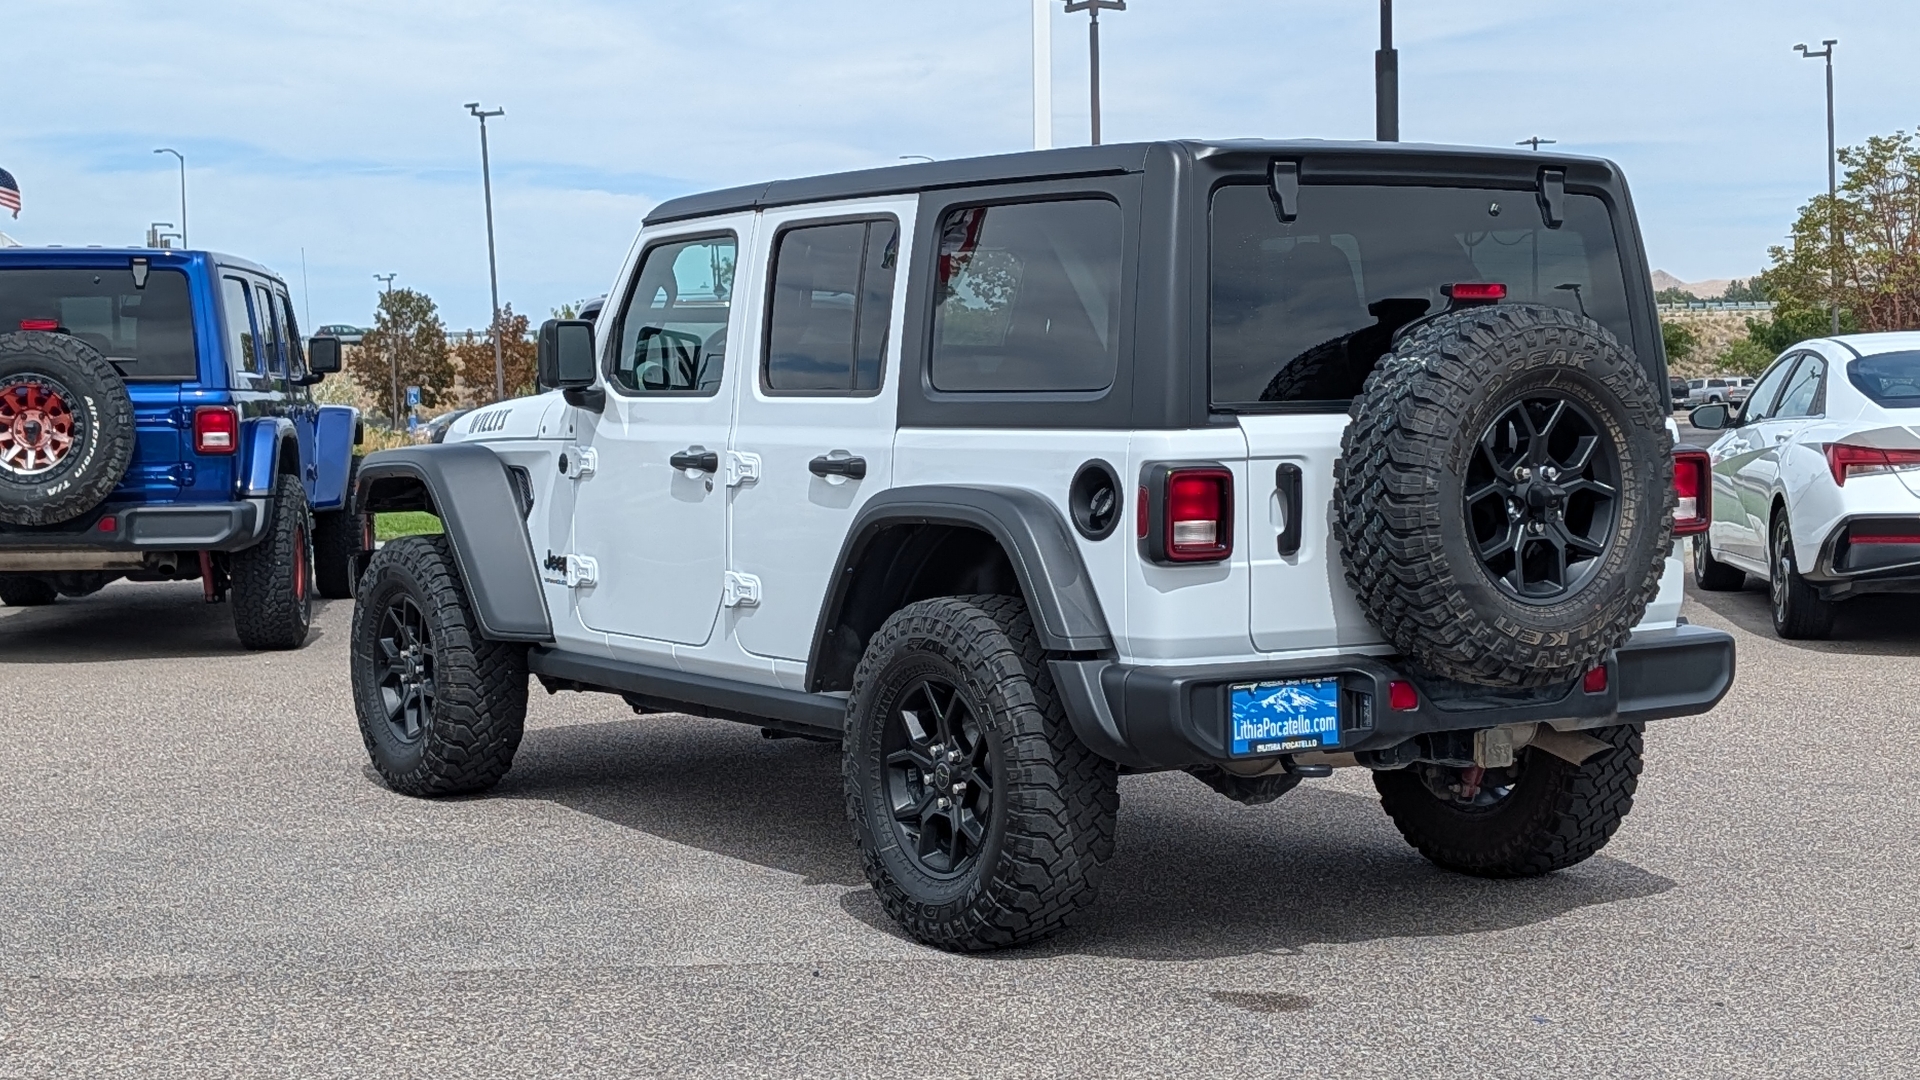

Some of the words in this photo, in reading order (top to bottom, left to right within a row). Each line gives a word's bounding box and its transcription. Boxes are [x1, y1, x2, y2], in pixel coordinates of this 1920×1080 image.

[468, 408, 513, 434] WILLYS
[1233, 715, 1336, 741] LithiaPocatello.com
[1282, 739, 1318, 750] POCATELLO
